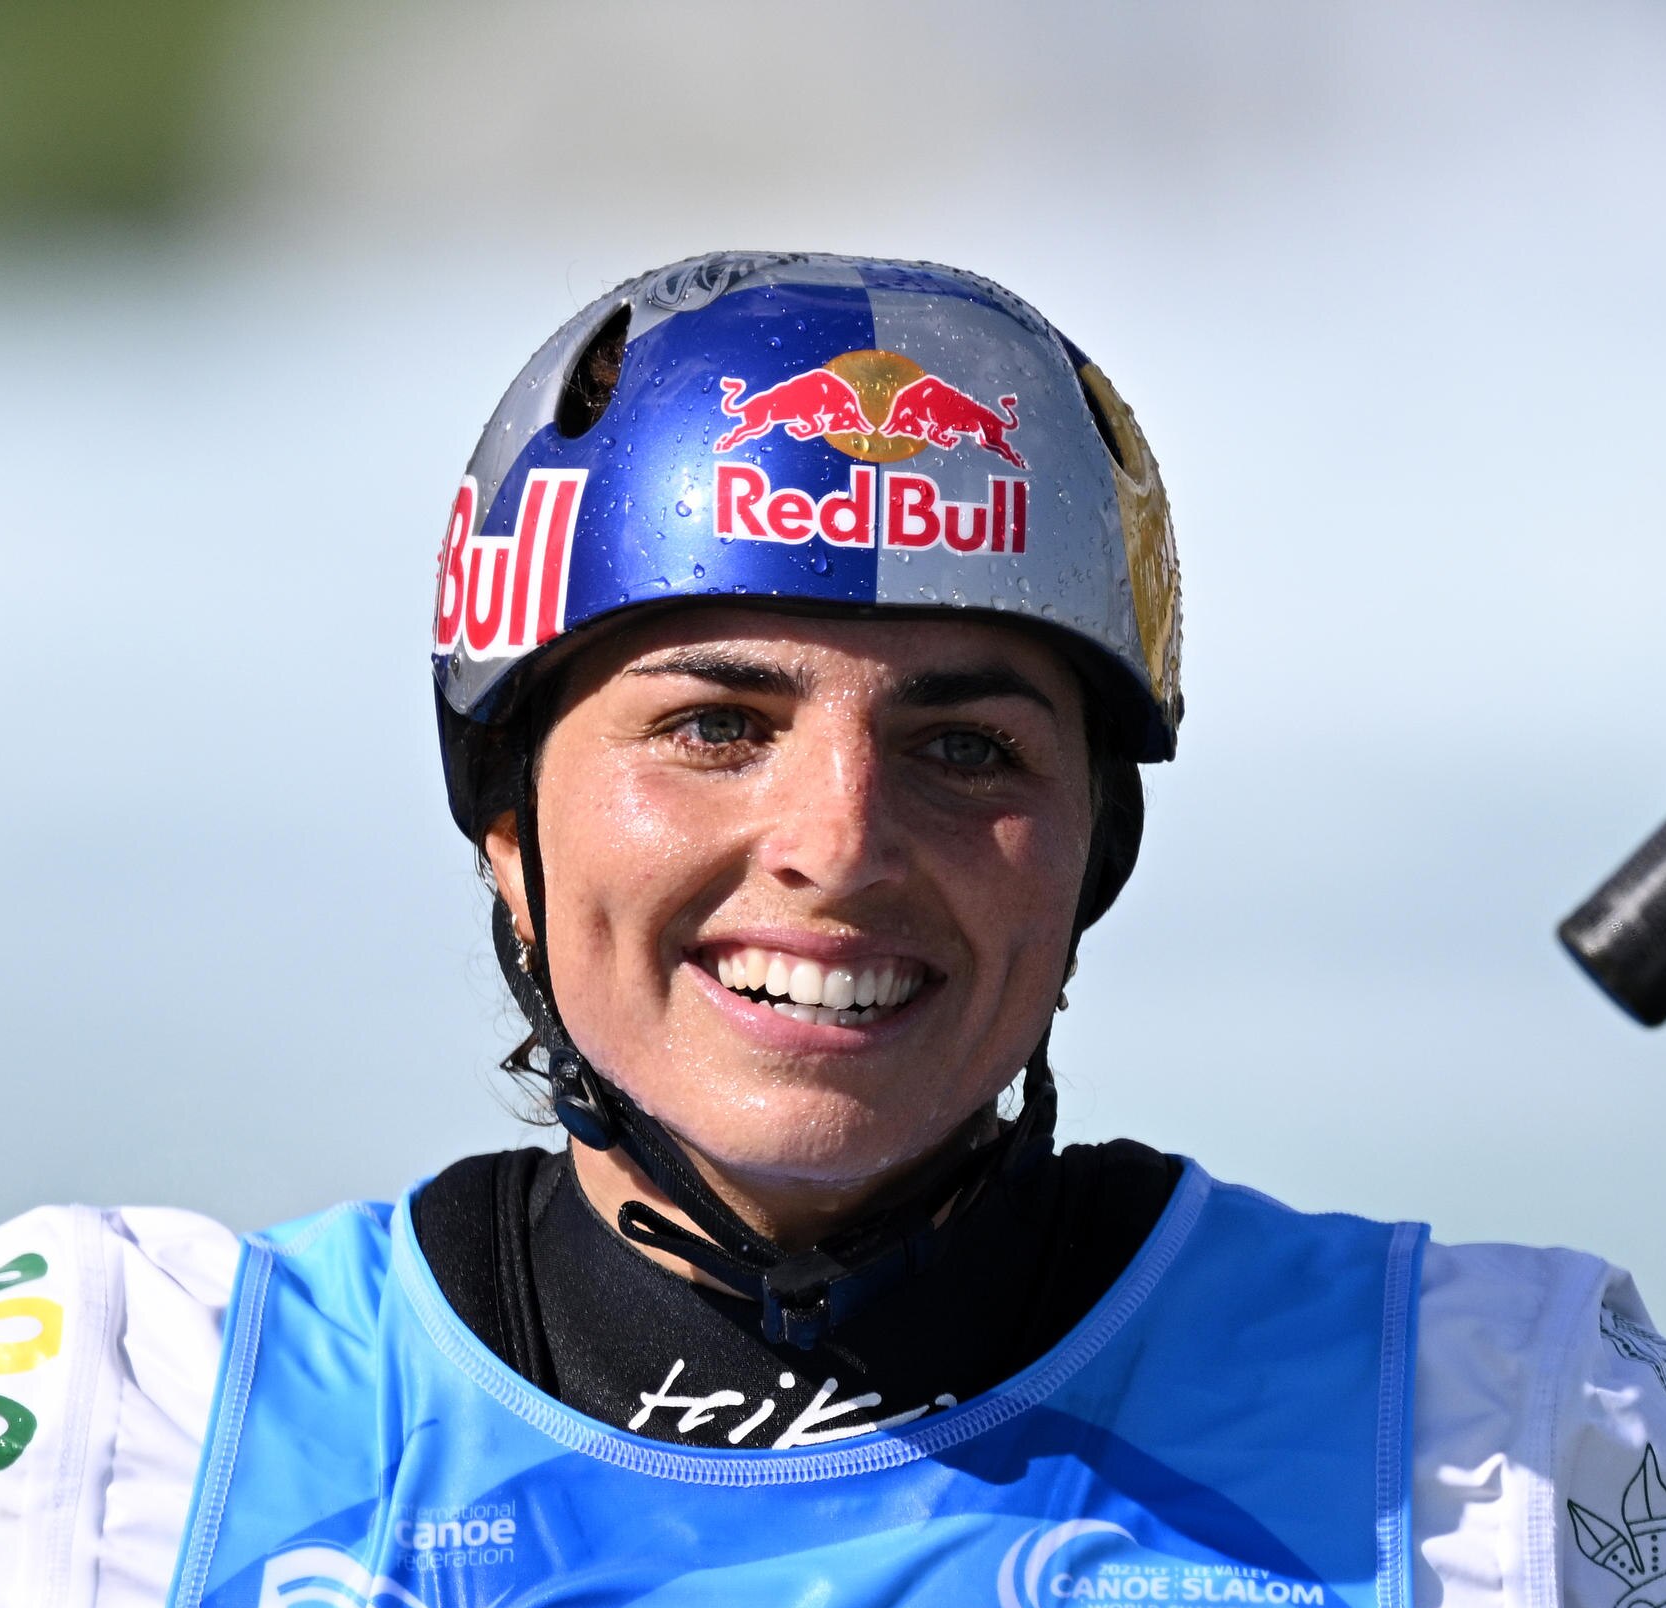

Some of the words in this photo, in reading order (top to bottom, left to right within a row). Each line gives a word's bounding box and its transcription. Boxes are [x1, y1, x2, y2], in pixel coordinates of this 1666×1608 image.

[715, 463, 875, 548] Red
[883, 473, 1028, 554] Bull
[435, 480, 579, 651] Bull
[394, 1518, 516, 1551] canoe
[1049, 1572, 1171, 1601] CANOE
[1182, 1576, 1325, 1606] SLALOM
[1215, 1564, 1270, 1581] VALLEY
